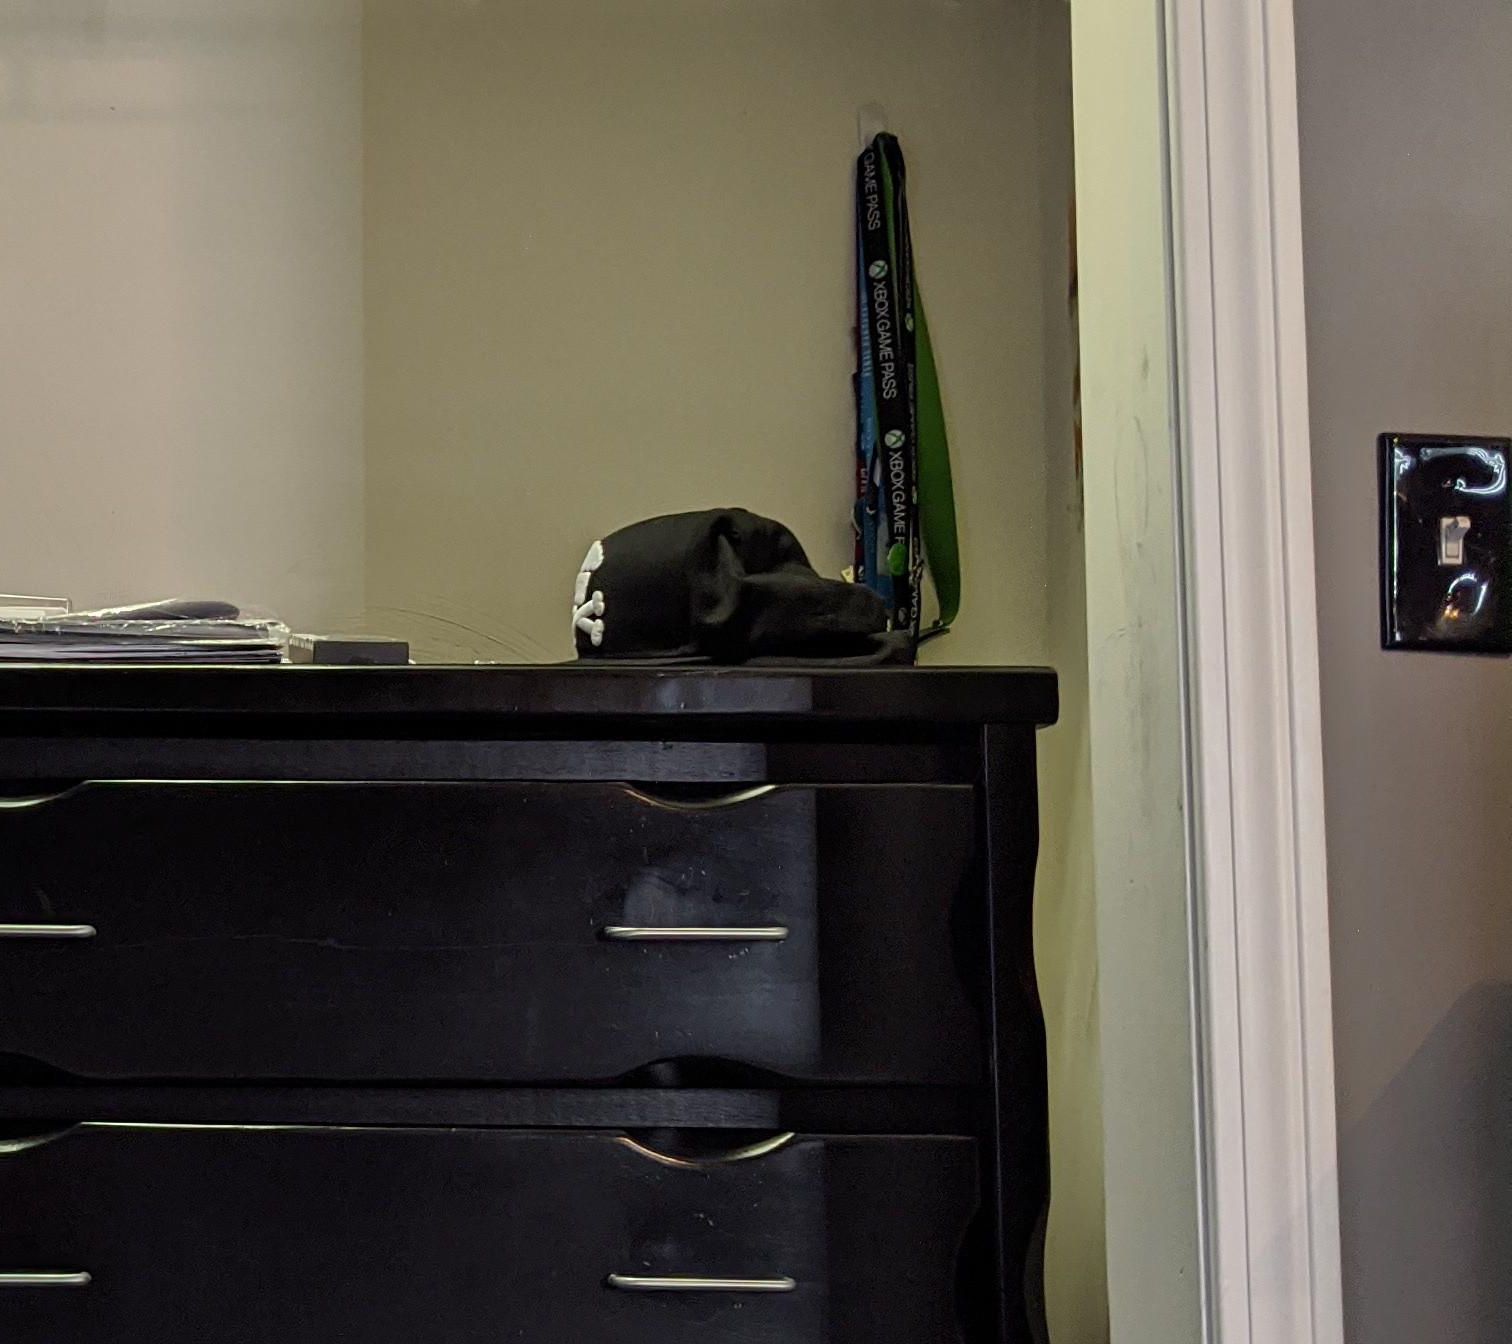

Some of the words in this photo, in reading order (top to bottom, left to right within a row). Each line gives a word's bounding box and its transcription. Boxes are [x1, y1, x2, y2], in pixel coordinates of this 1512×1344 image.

[863, 151, 878, 193] GAME
[867, 194, 881, 231] PASS
[873, 281, 890, 320] XBOX
[876, 319, 894, 362] GAME
[880, 362, 898, 399] PASS
[889, 451, 906, 490] XBOX
[891, 490, 907, 533] GAME
